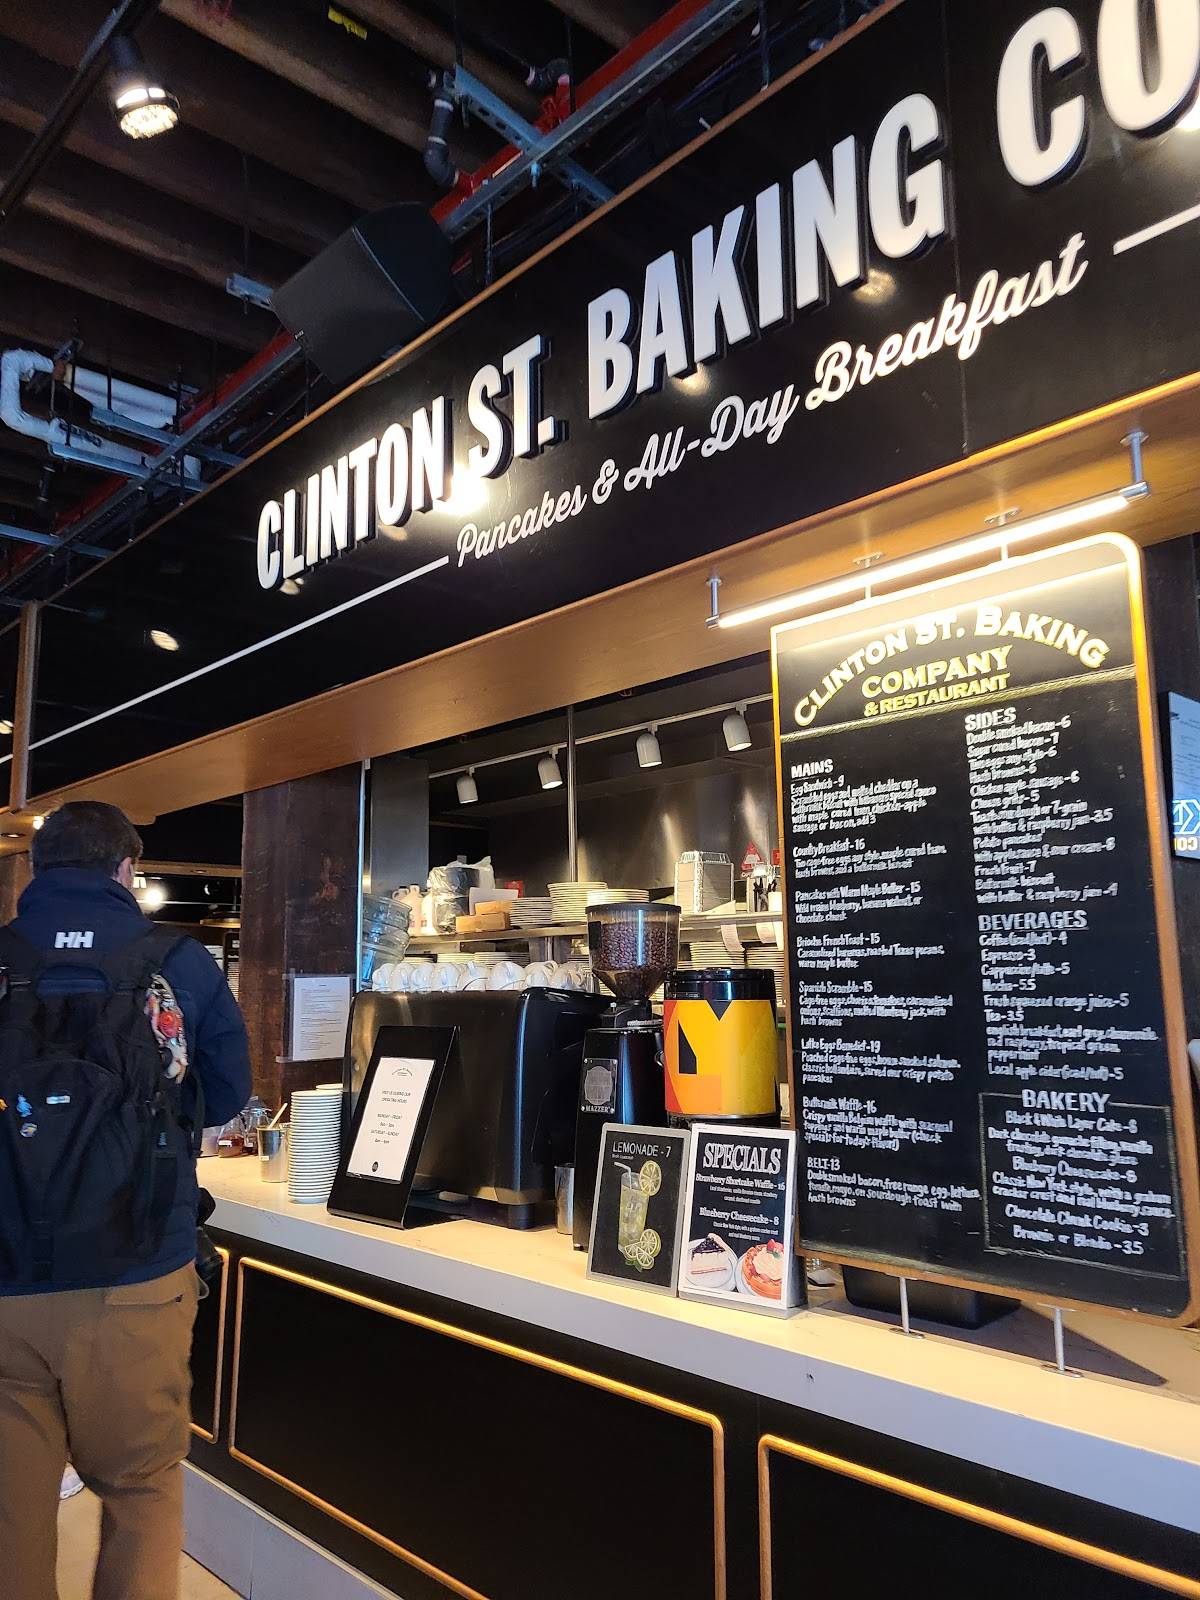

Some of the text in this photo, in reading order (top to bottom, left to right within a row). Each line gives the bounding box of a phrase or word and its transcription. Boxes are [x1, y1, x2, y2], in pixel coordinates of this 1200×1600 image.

[257, 396, 444, 589] CLINTON
[468, 335, 554, 478] ST.
[588, 93, 945, 419] BAKING
[457, 231, 1089, 568] Pancakes & All-Day Breakfast
[794, 604, 1112, 727] CLINTON ST. BAKING
[861, 644, 1013, 699] COMPANY
[879, 672, 1011, 714] RESTAURANT
[965, 707, 1016, 731] SIDES
[791, 759, 834, 779] MAINS
[791, 782, 803, 795] Egg
[831, 808, 852, 818] cured
[793, 821, 818, 835] sausage
[819, 822, 827, 830] or
[856, 816, 869, 826] add
[870, 815, 876, 824] 3
[795, 889, 826, 902] Pancakes
[840, 885, 860, 898] Warm
[882, 882, 905, 894] Butter
[796, 913, 825, 923] chocolate
[978, 910, 1088, 931] BEVERAGES
[54, 931, 94, 948] HH
[893, 943, 914, 956] Texas
[799, 980, 859, 996] Spanish Scramble
[820, 1038, 836, 1053] Eggs
[836, 1038, 867, 1051] Benedict
[802, 1051, 828, 1063] Poached
[802, 1063, 825, 1073] classic
[903, 1068, 926, 1083] crispy
[802, 1073, 833, 1084] pancakes
[803, 1096, 838, 1110] Buttermilk
[1022, 1089, 1110, 1113] BAKERY
[802, 1109, 825, 1124] Crispy
[1096, 1118, 1123, 1132] Cake
[613, 1141, 659, 1157] LEMONADE
[666, 1146, 671, 1157] 7
[703, 1142, 782, 1175] SPECIALS
[696, 1173, 725, 1185] Strawberry
[726, 1176, 754, 1187] Shortcake
[754, 1179, 774, 1189] Waffle
[808, 1192, 857, 1207] hash browns
[855, 1187, 866, 1197] on
[913, 1196, 938, 1209] toast
[940, 1200, 963, 1212] with
[699, 1207, 730, 1220] Blueberry
[731, 1211, 768, 1224] Cheesecake
[1005, 1203, 1057, 1223] Chocolate
[1013, 1224, 1055, 1243] Brownie
[1058, 1234, 1070, 1243] or
